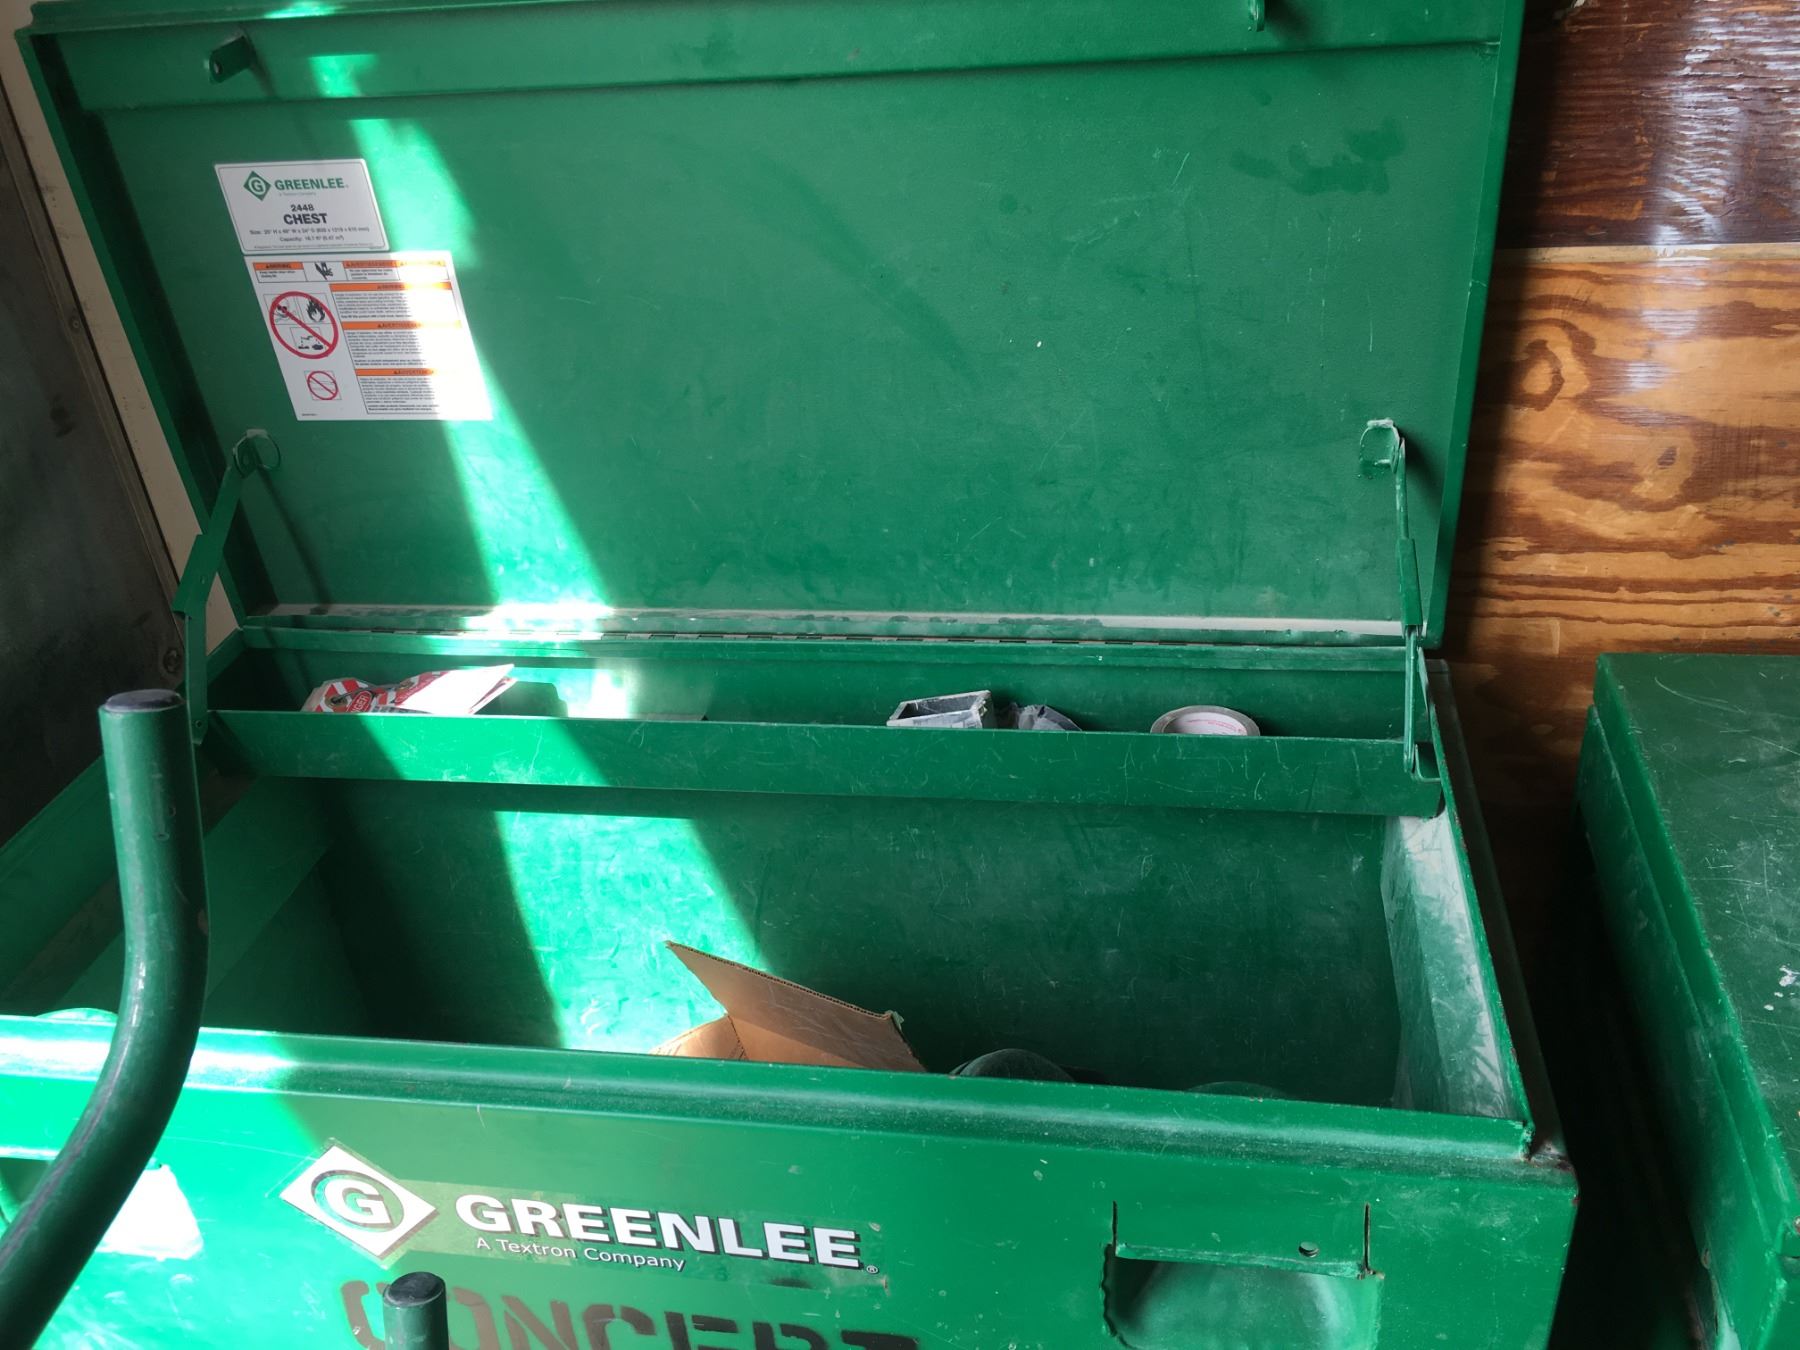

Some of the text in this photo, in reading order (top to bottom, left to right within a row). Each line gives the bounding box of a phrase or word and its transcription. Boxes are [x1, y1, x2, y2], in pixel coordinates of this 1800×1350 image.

[251, 178, 345, 192] G GREENLEE
[290, 203, 315, 213] 2448
[283, 213, 328, 225] CHEST
[322, 1179, 862, 1268] G GREENLEE
[476, 1236, 687, 1273] A Textron Company
